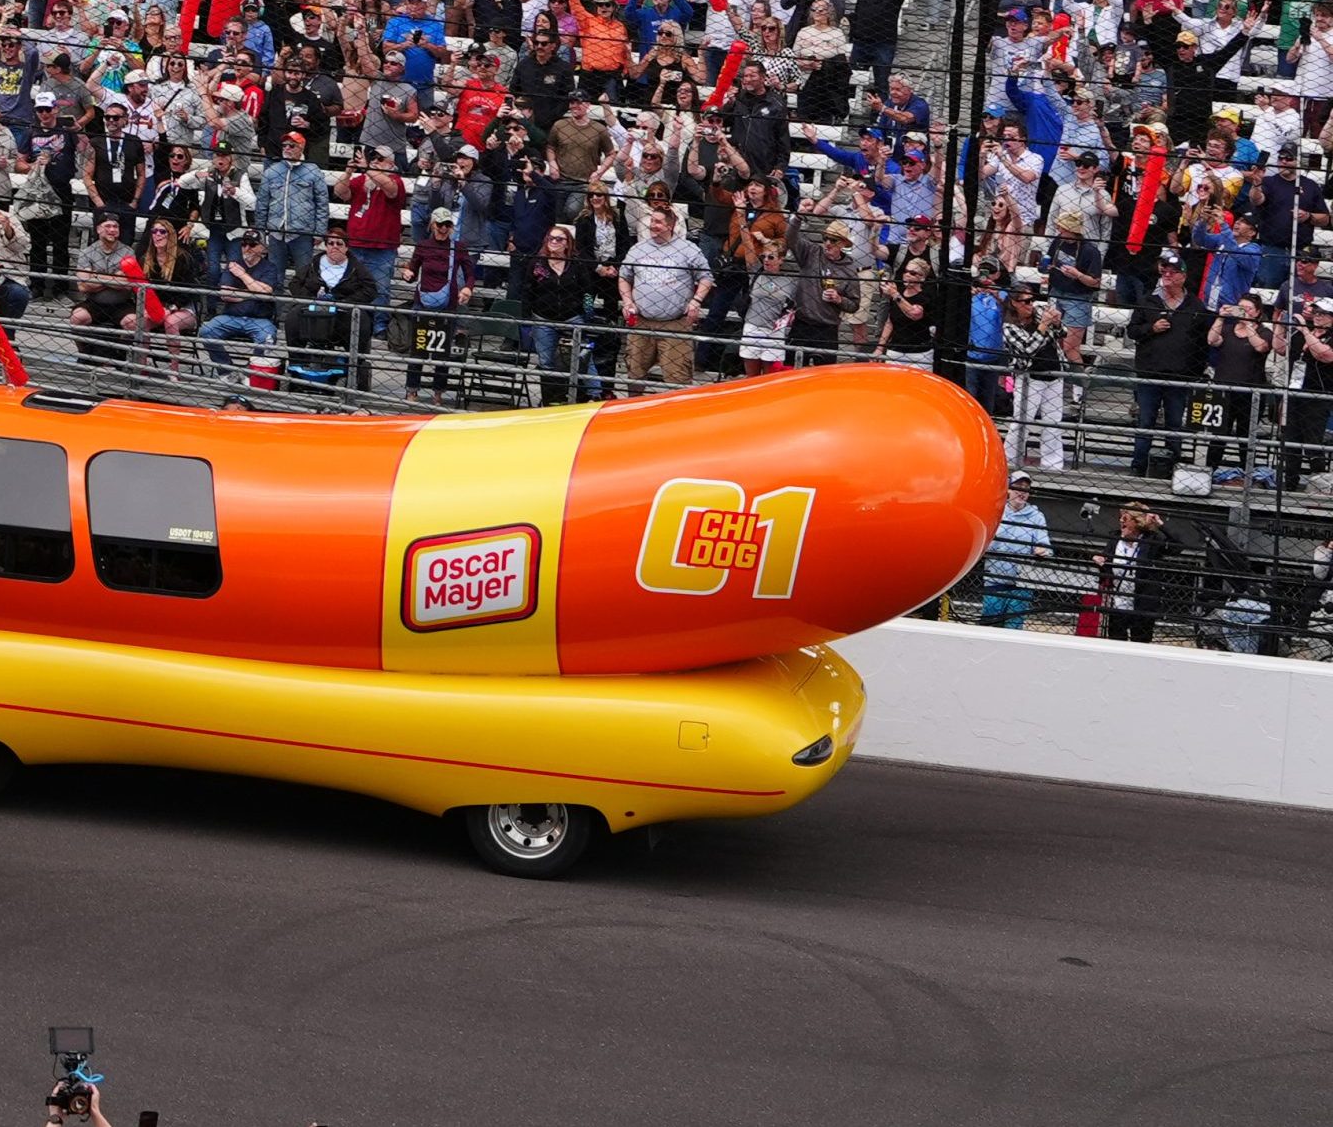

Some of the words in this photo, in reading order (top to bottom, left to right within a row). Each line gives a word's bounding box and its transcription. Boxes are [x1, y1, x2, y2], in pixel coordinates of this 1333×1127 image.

[416, 328, 426, 350] BOX
[426, 330, 446, 352] 22
[1192, 402, 1202, 424] BOX
[1202, 403, 1224, 427] 23
[698, 509, 760, 542] CHI
[428, 546, 515, 582] Oscar
[690, 538, 760, 570] DOG
[424, 572, 516, 610] Mayer
